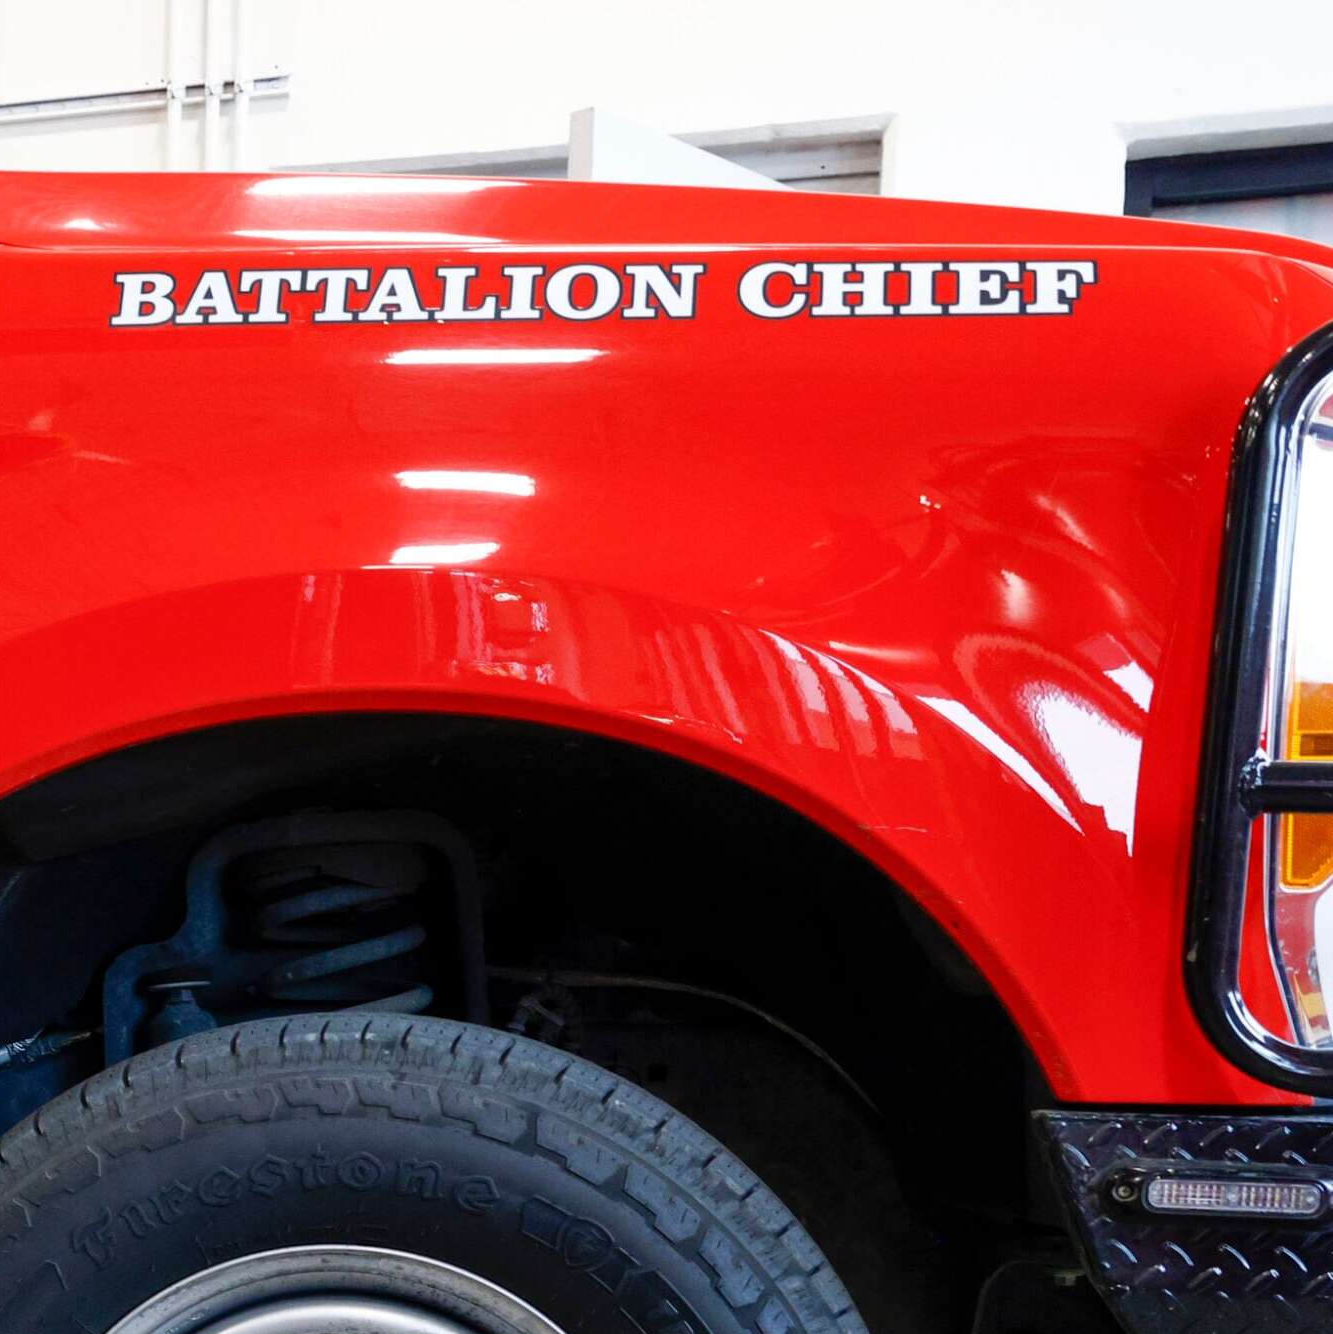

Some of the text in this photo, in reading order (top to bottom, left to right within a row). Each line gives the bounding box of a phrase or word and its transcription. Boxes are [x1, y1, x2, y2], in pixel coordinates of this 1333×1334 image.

[108, 260, 1099, 328] BATTALION CHIEF
[71, 1143, 500, 1271] Firestone
